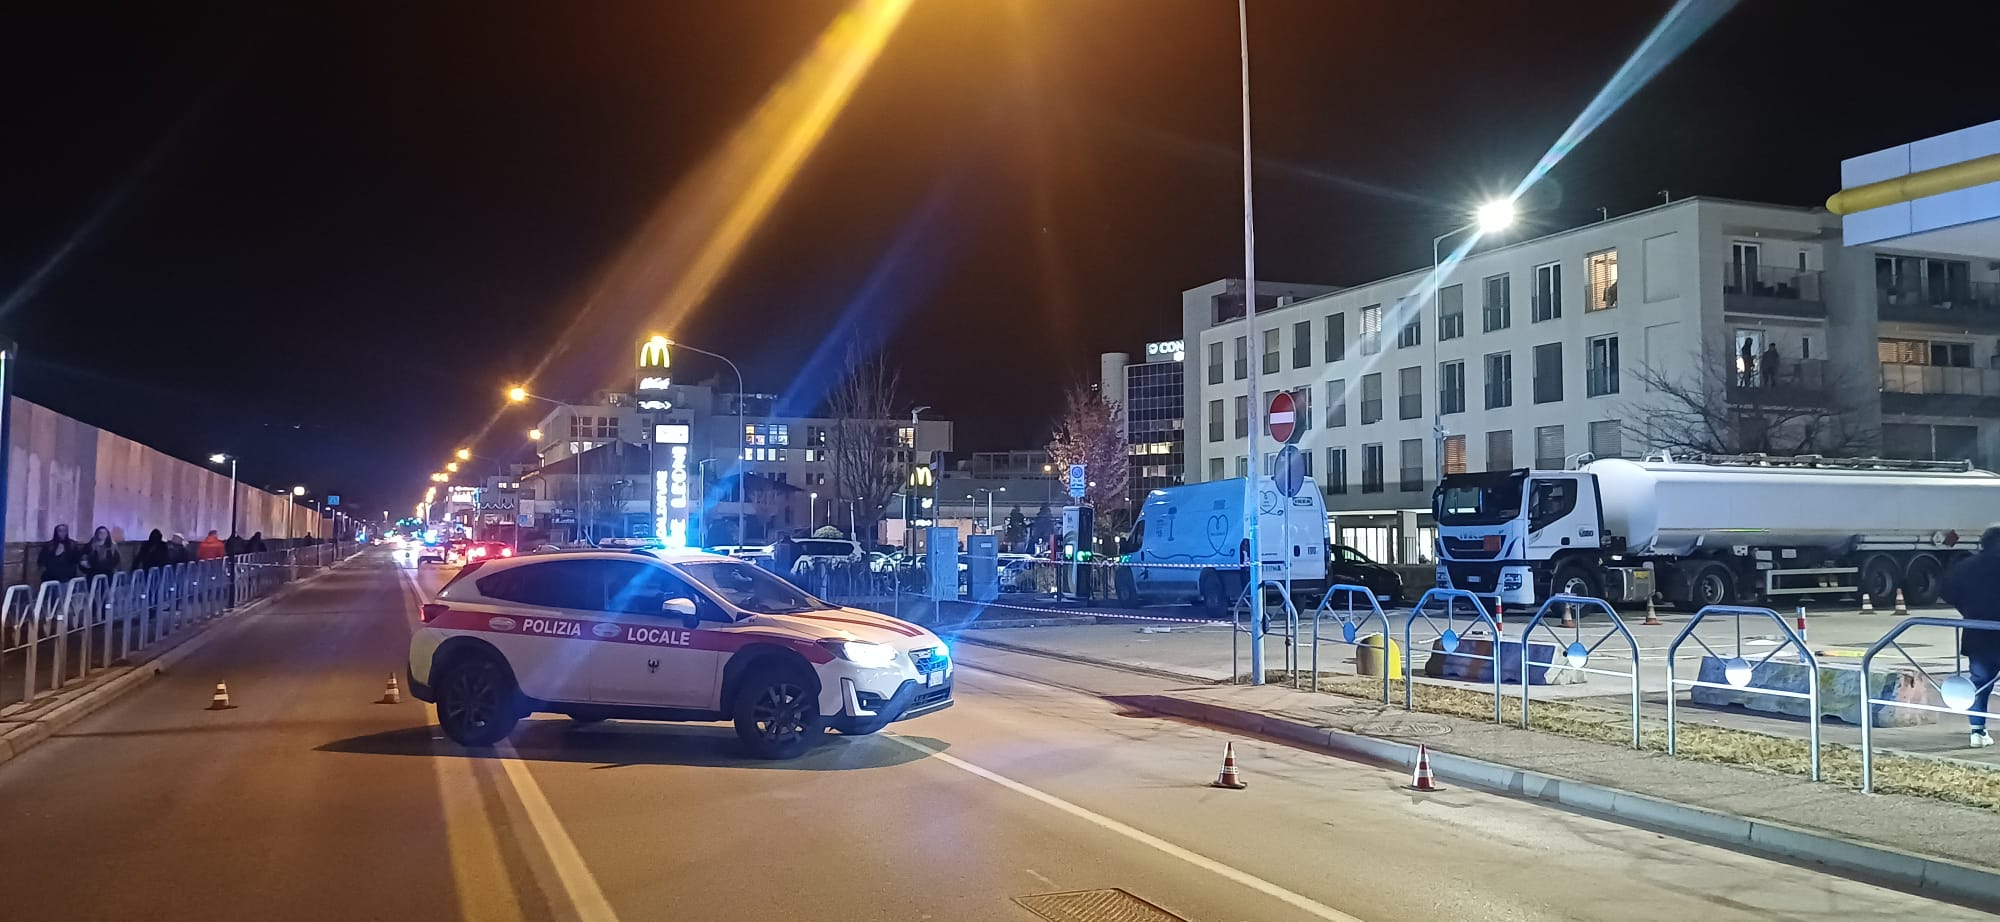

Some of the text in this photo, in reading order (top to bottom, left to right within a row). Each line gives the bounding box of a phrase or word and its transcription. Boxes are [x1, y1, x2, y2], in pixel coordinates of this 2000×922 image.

[671, 446, 687, 508] LEONI
[522, 618, 582, 636] POLIZIA
[627, 627, 691, 646] LOCALE
